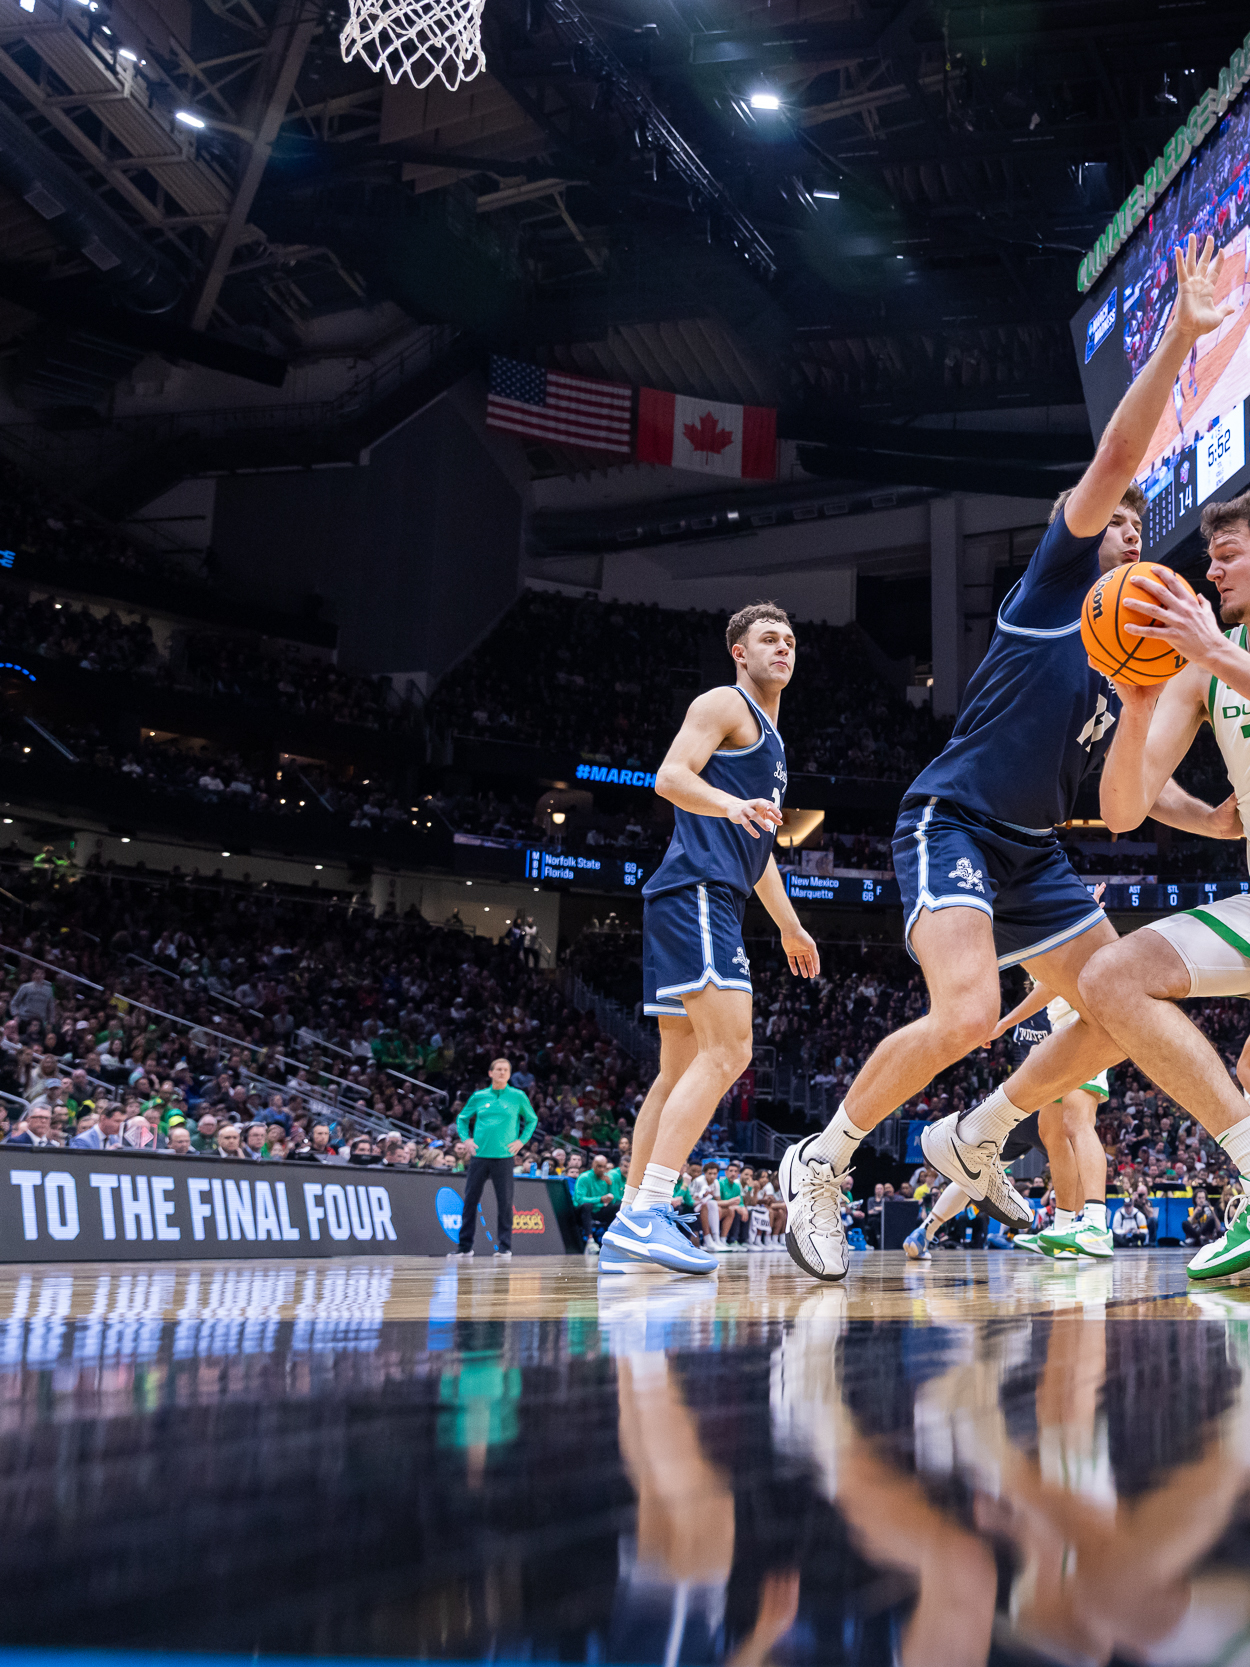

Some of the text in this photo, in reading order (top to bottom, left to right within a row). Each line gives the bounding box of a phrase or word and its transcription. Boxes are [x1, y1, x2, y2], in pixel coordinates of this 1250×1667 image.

[1078, 185, 1145, 291] CLIMATE
[1144, 88, 1217, 208] PLEDGE
[1093, 304, 1108, 333] MARCH
[1094, 308, 1116, 345] MADNESS
[1208, 429, 1231, 467] 5:52
[1178, 484, 1192, 517] 14
[545, 854, 576, 868] Norfolk
[577, 857, 600, 870] State
[637, 868, 644, 879] F
[545, 866, 636, 886] Florida 95
[791, 875, 882, 895] New Mexico 75 F
[791, 887, 874, 901] Marquette 66
[1129, 885, 1141, 894] AST
[1167, 885, 1179, 894] STL
[1205, 883, 1217, 892] BLK
[1240, 882, 1249, 890] TO
[1131, 892, 1214, 907] 5 0 1
[10, 1170, 398, 1241] TO THE FINAL FOUR
[442, 1214, 463, 1229] NC
[512, 1212, 543, 1229] eese's
